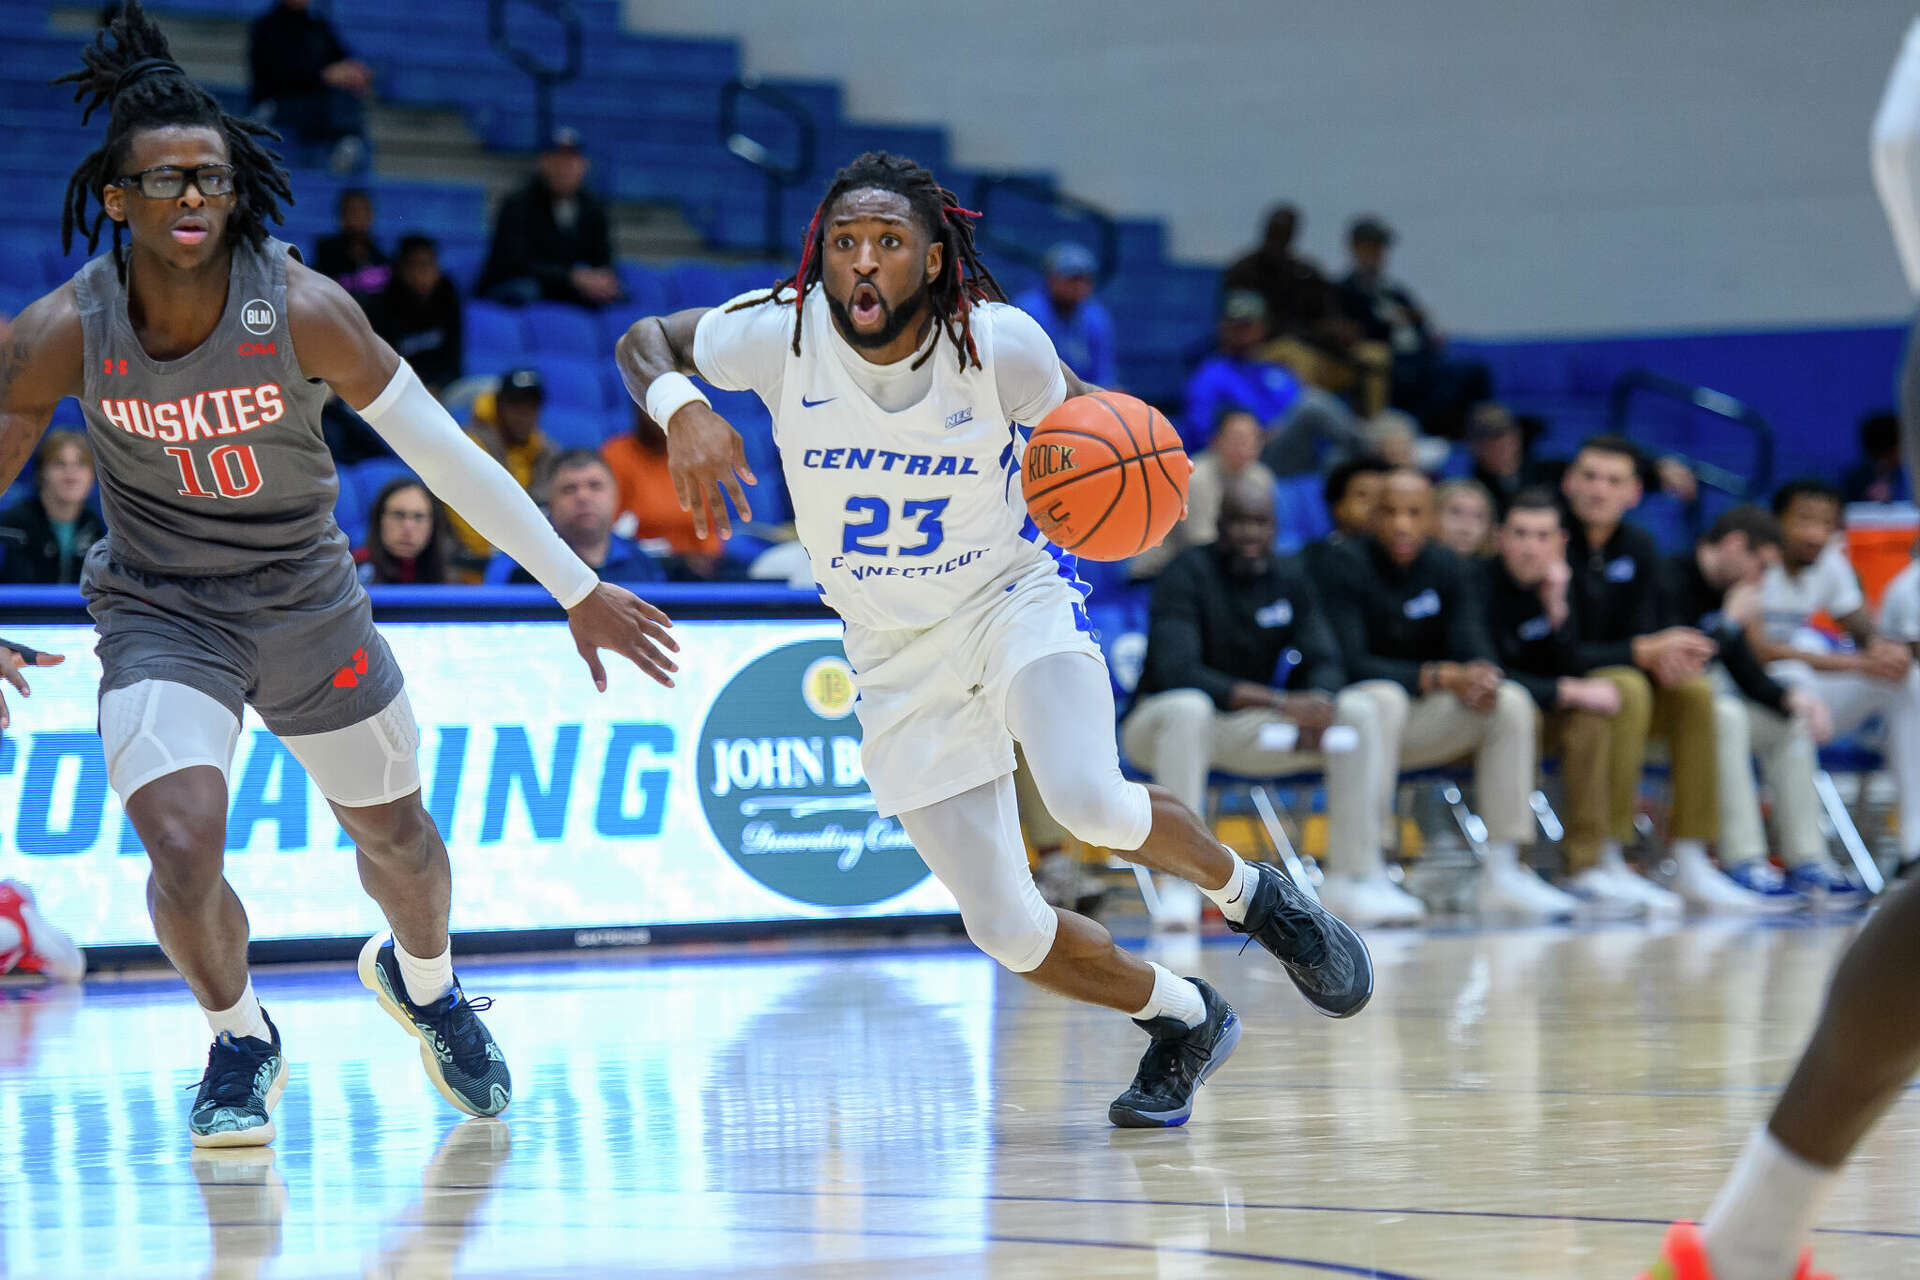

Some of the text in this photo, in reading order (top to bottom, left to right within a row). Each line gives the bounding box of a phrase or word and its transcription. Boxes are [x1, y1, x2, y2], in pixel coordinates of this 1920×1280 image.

[247, 309, 272, 325] BLM
[101, 383, 286, 443] HUSKIES
[944, 407, 973, 430] NEC
[164, 444, 264, 499] 10
[803, 448, 979, 476] CENTRAL
[1028, 443, 1075, 482] ROCK
[842, 495, 951, 557] 23
[831, 548, 990, 581] CNNECTICUT
[711, 735, 868, 796] JOHN B
[0, 723, 675, 857] OAING
